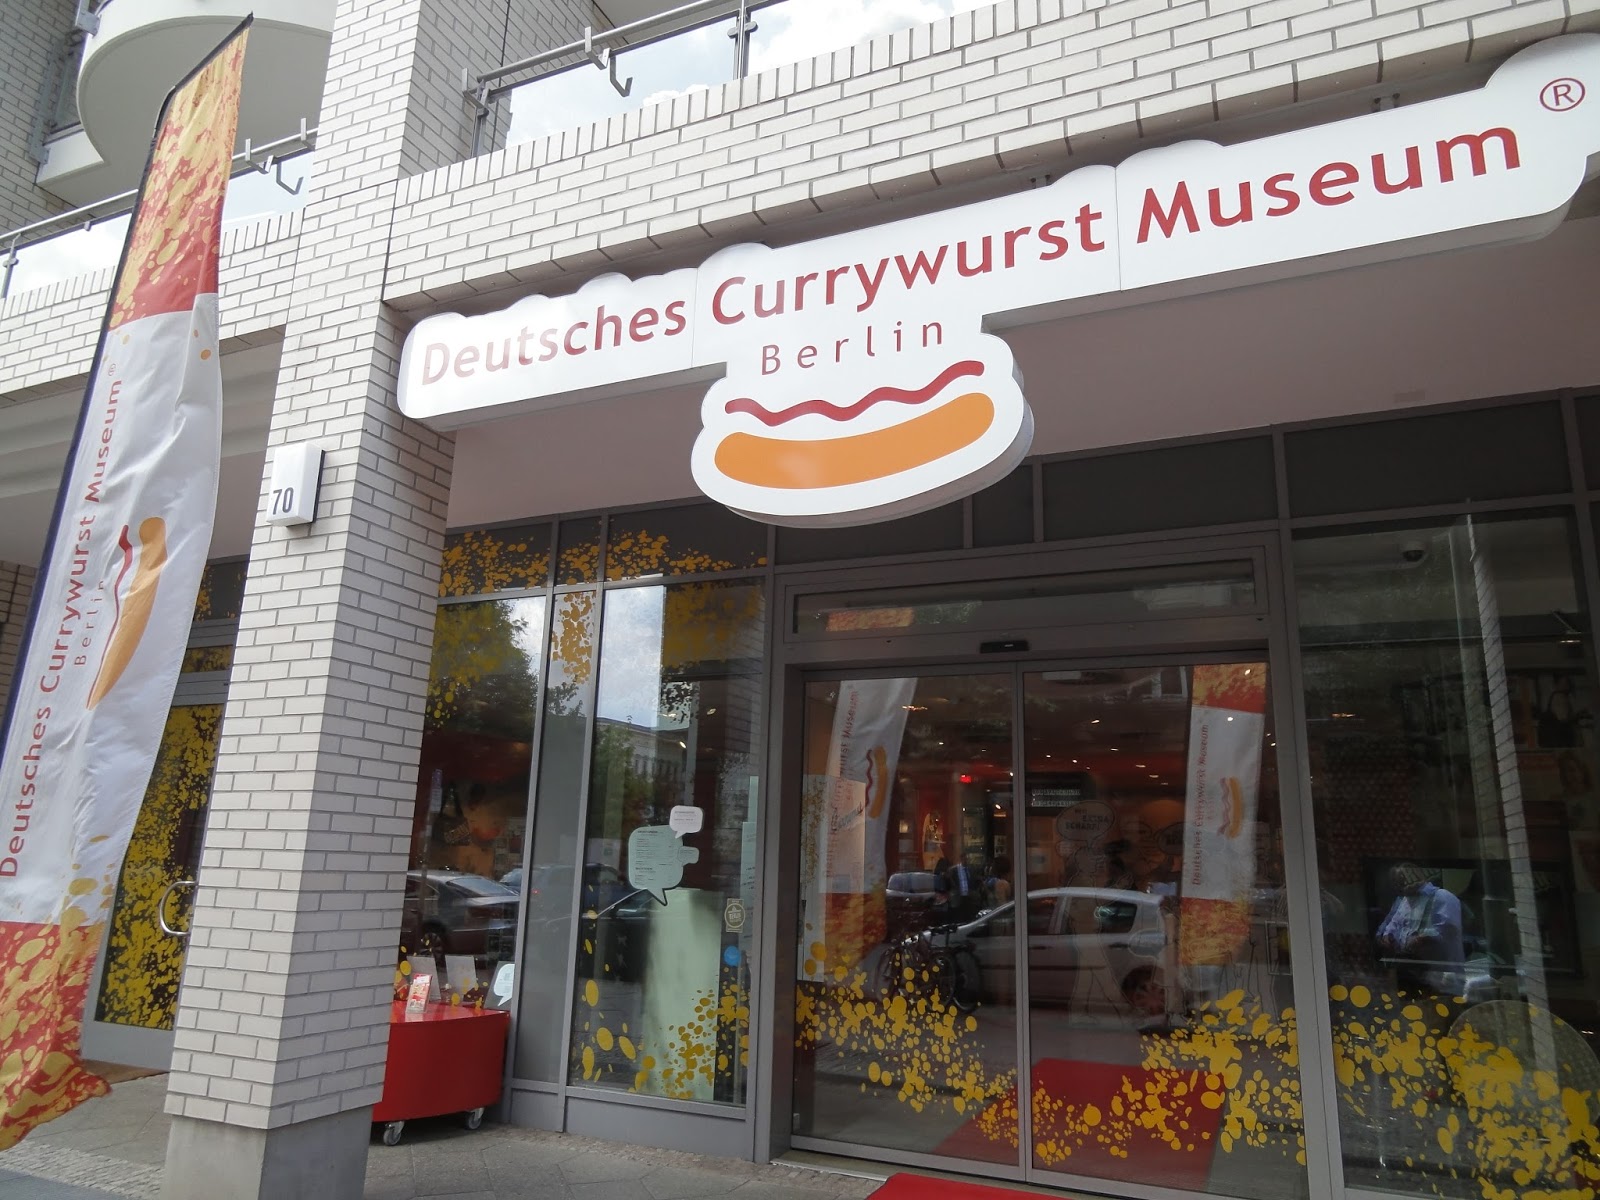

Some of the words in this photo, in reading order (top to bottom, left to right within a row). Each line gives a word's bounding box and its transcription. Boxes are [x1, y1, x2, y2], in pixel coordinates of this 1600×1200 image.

[421, 300, 686, 386] Deutsches
[712, 203, 1106, 325] Currywurst
[1136, 125, 1521, 244] Museum
[761, 320, 943, 376] Berlin
[272, 487, 295, 515] 70
[0, 706, 51, 878] Deutsches
[40, 515, 96, 694] Currywurst
[84, 380, 122, 503] Museum
